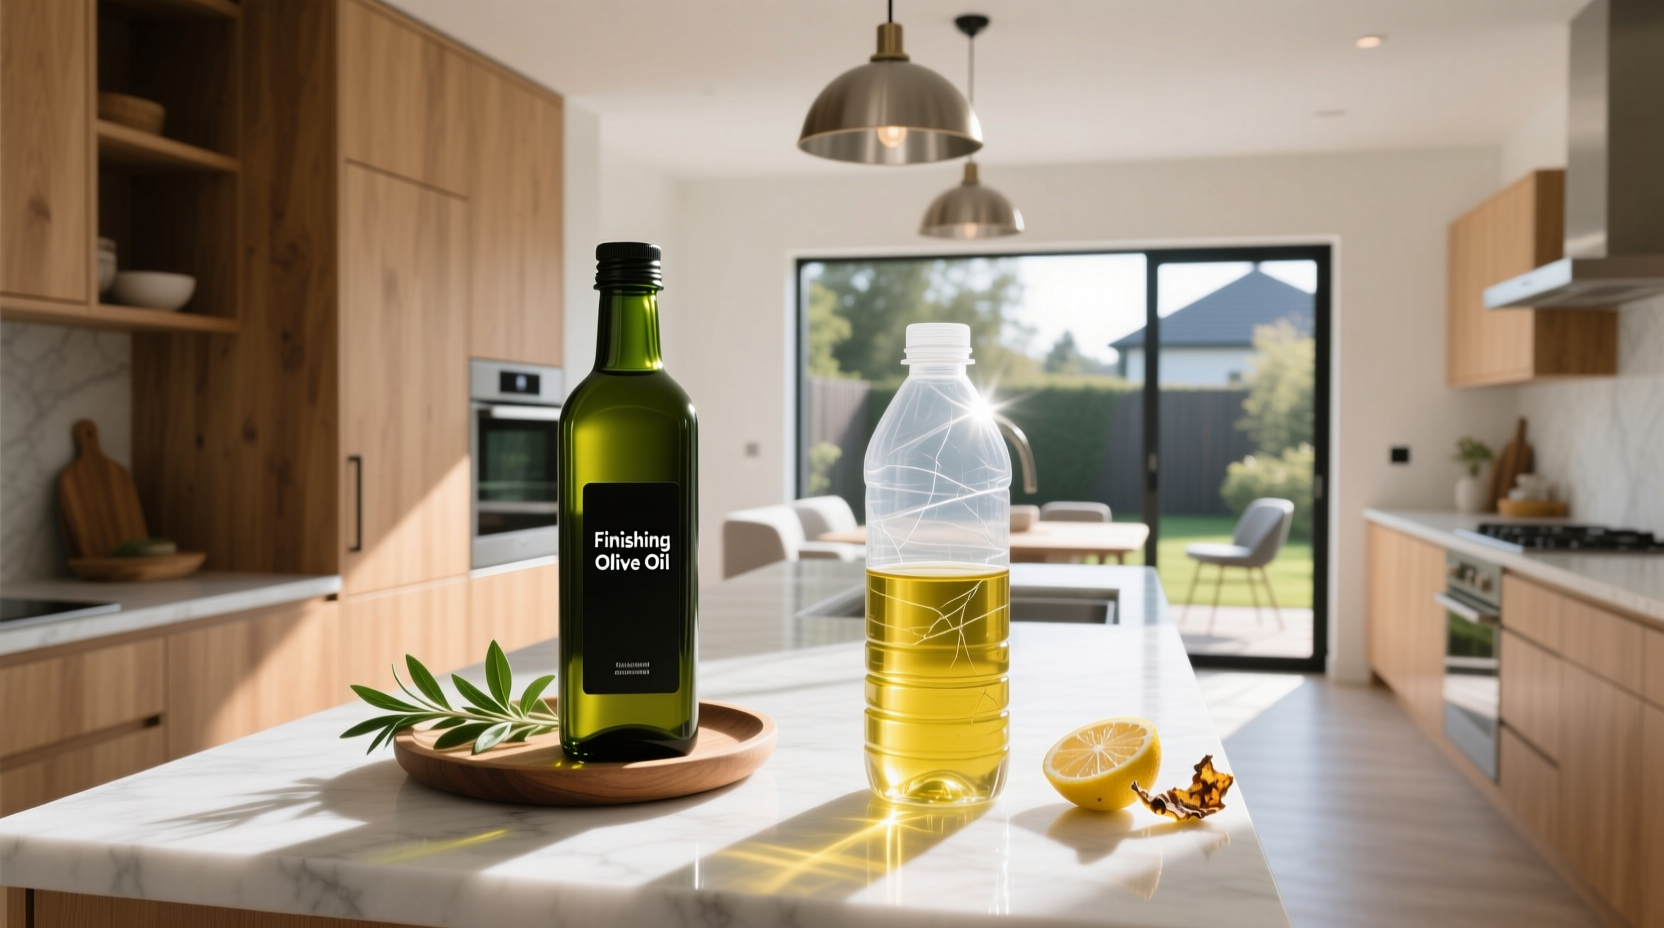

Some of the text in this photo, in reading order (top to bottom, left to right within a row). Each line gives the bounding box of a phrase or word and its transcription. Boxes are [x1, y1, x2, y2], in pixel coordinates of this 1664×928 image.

[594, 530, 671, 552] Finishing
[594, 553, 670, 571] Olive Oil
